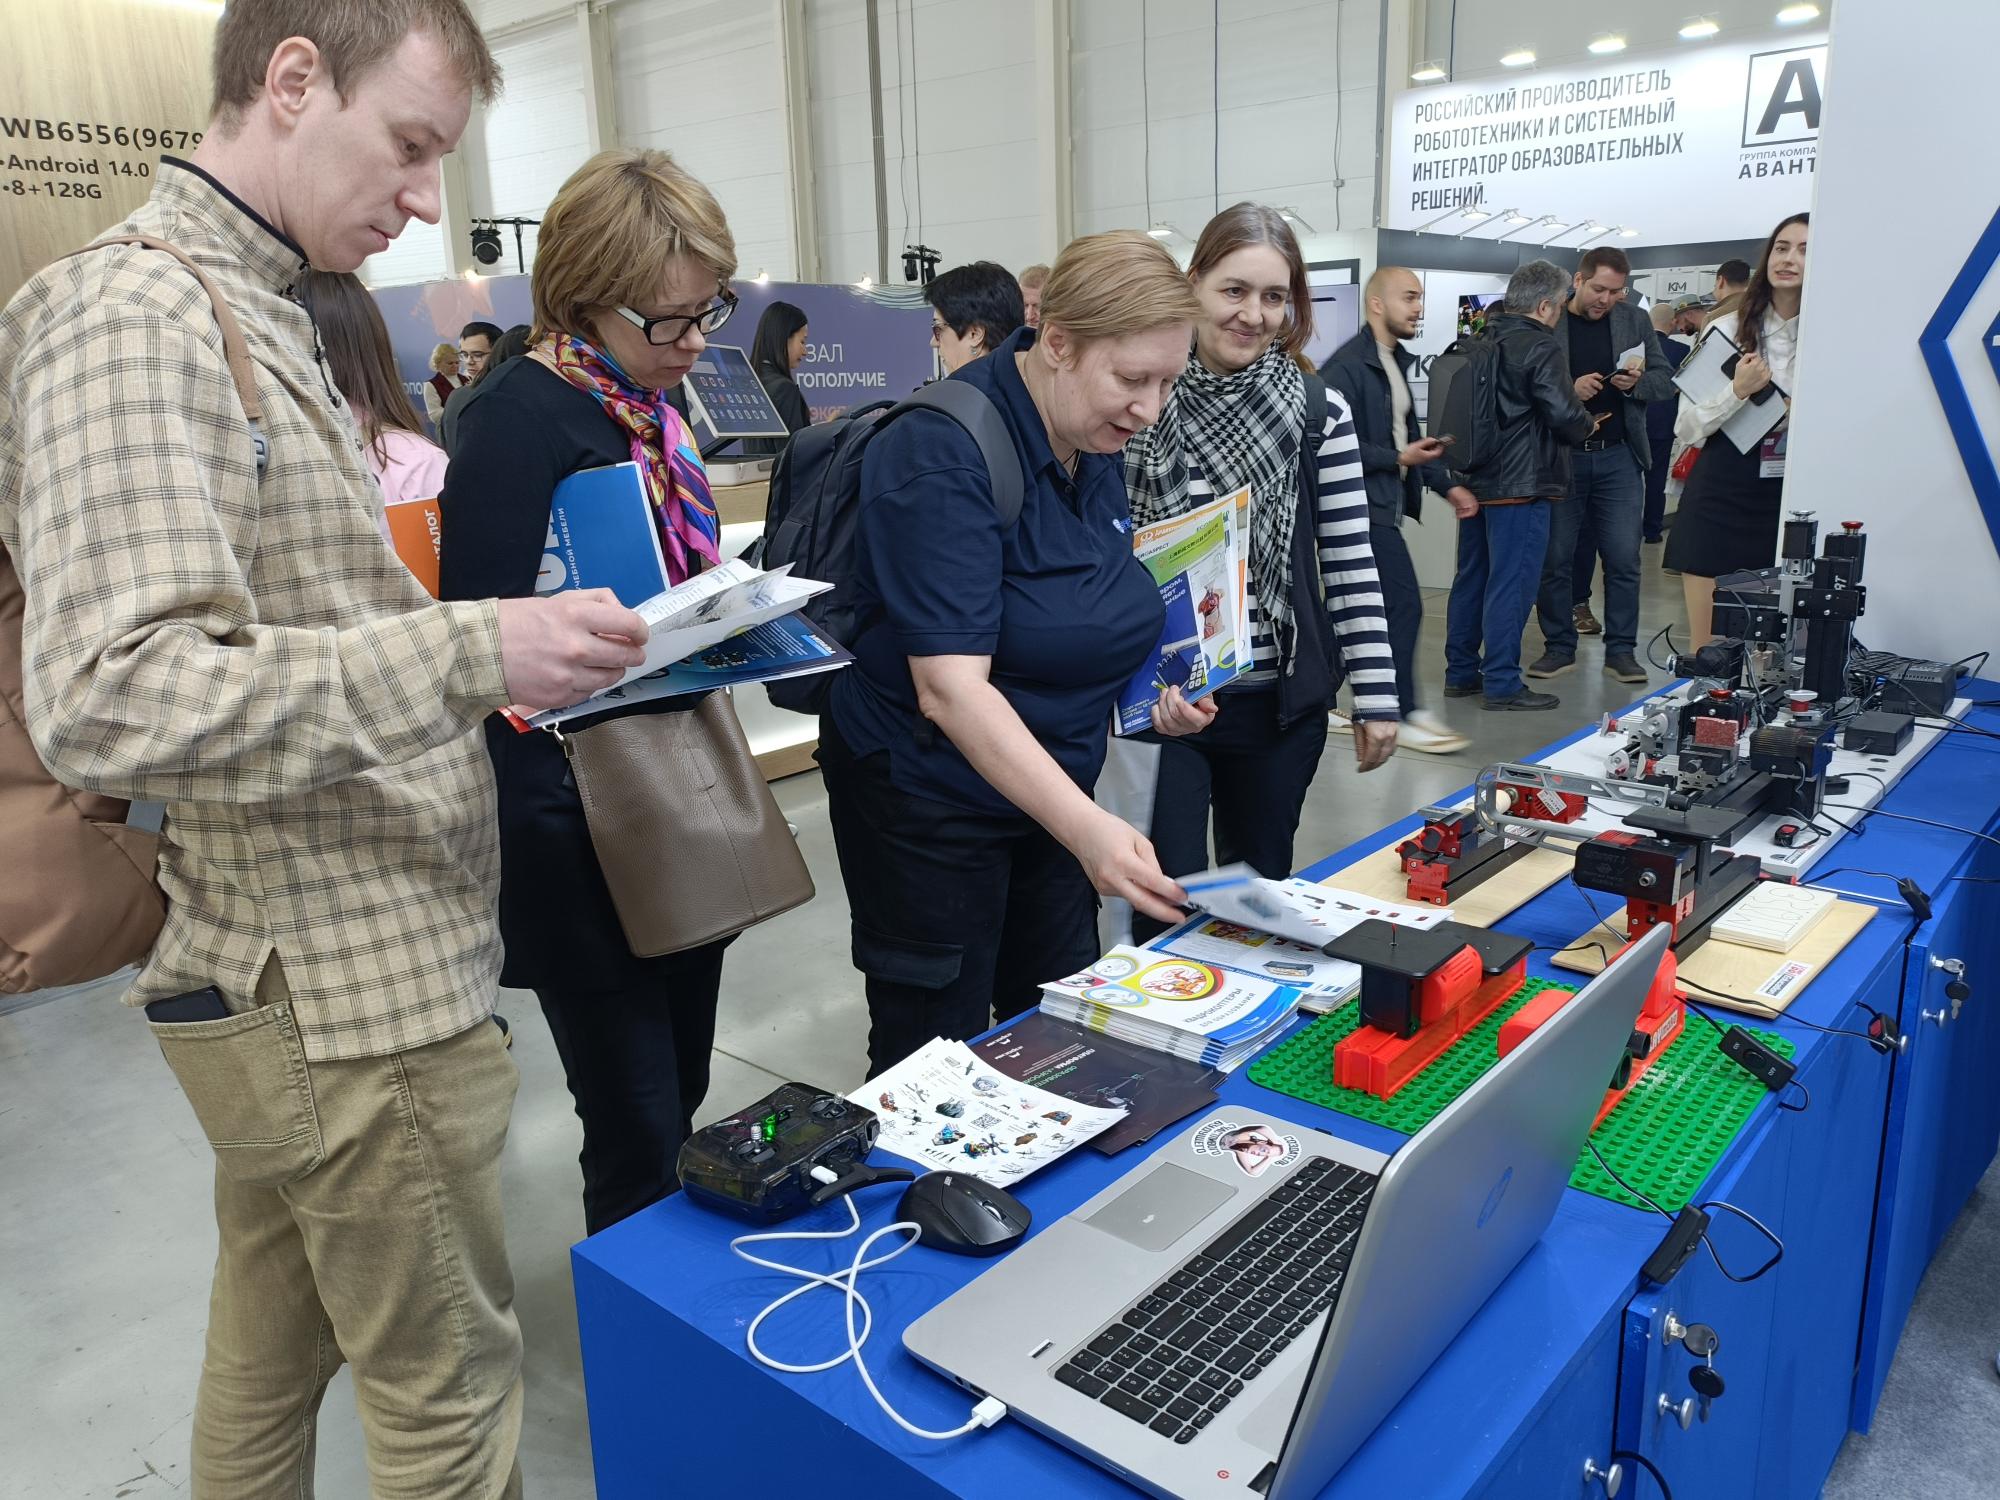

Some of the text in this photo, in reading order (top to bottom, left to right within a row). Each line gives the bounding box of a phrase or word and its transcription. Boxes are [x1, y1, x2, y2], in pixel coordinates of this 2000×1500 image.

[1415, 68, 1672, 124] РОССИЙСКИЙ ПРОИЗВОДИТЕЛЬ
[1414, 97, 1675, 153] РОБОТОТЕХНИКИ И СИСТЕМНЫЙ
[109, 161, 149, 177] 14.0
[1412, 132, 1684, 183] ИНТЕГРАТОР ОБРАЗОВАТЕЛЬНЫХ
[1739, 150, 1777, 161] ГРУППА
[1411, 182, 1488, 211] РЕШЕНИЙ.
[805, 343, 843, 363] ЗАЛ
[424, 509, 441, 560] ТАЛОГ
[557, 507, 572, 547] МЕБЕЛИ
